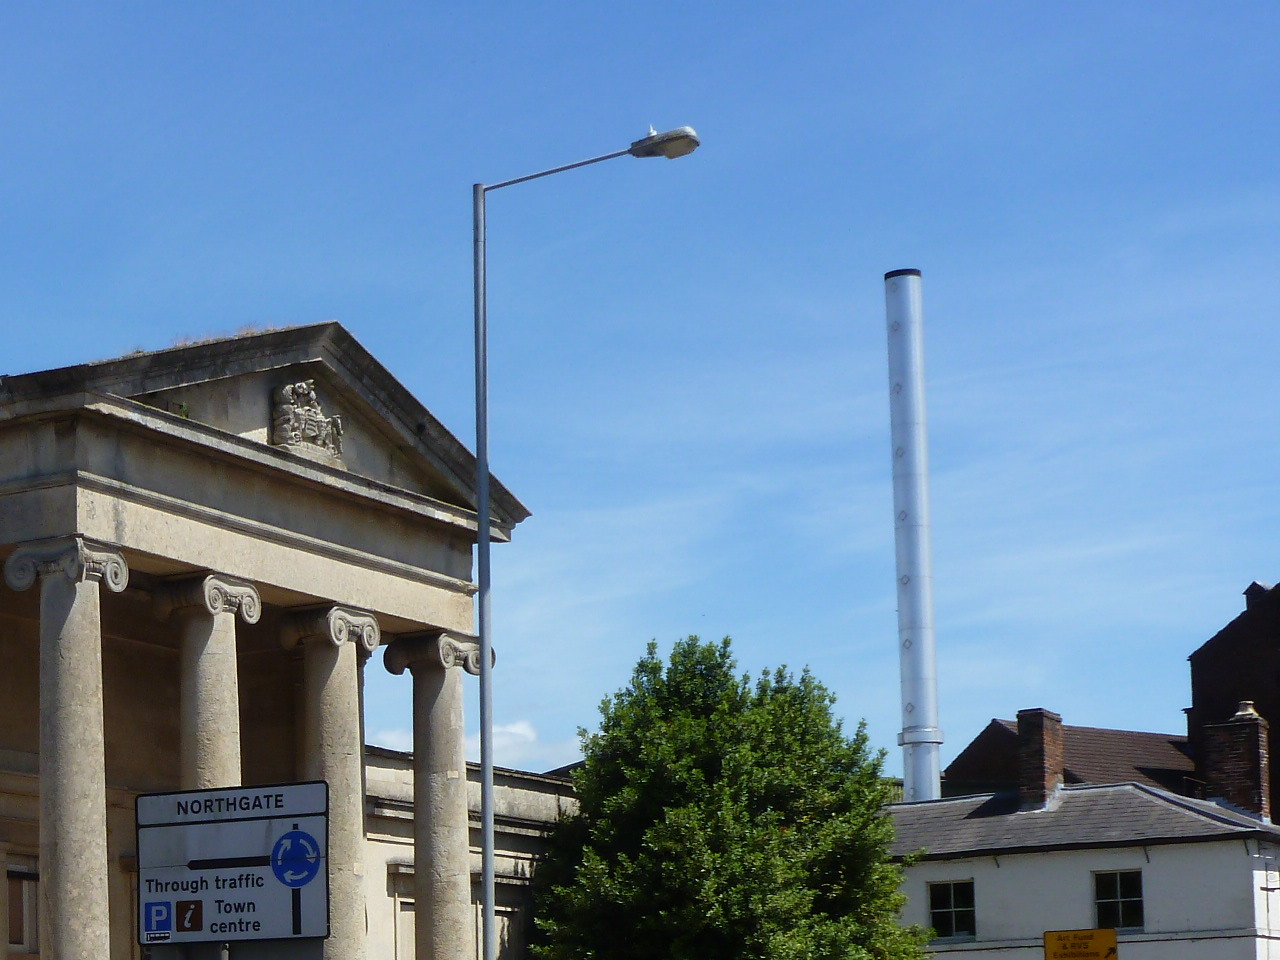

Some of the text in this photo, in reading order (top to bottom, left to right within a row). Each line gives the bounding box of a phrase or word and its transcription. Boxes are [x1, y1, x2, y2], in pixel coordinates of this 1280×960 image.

[177, 794, 284, 815] NORTHGATE
[146, 873, 264, 893] Through traffic
[215, 900, 256, 914] Town
[151, 905, 168, 930] P
[210, 918, 261, 933] centre
[1053, 951, 1100, 959] Exhibitions
